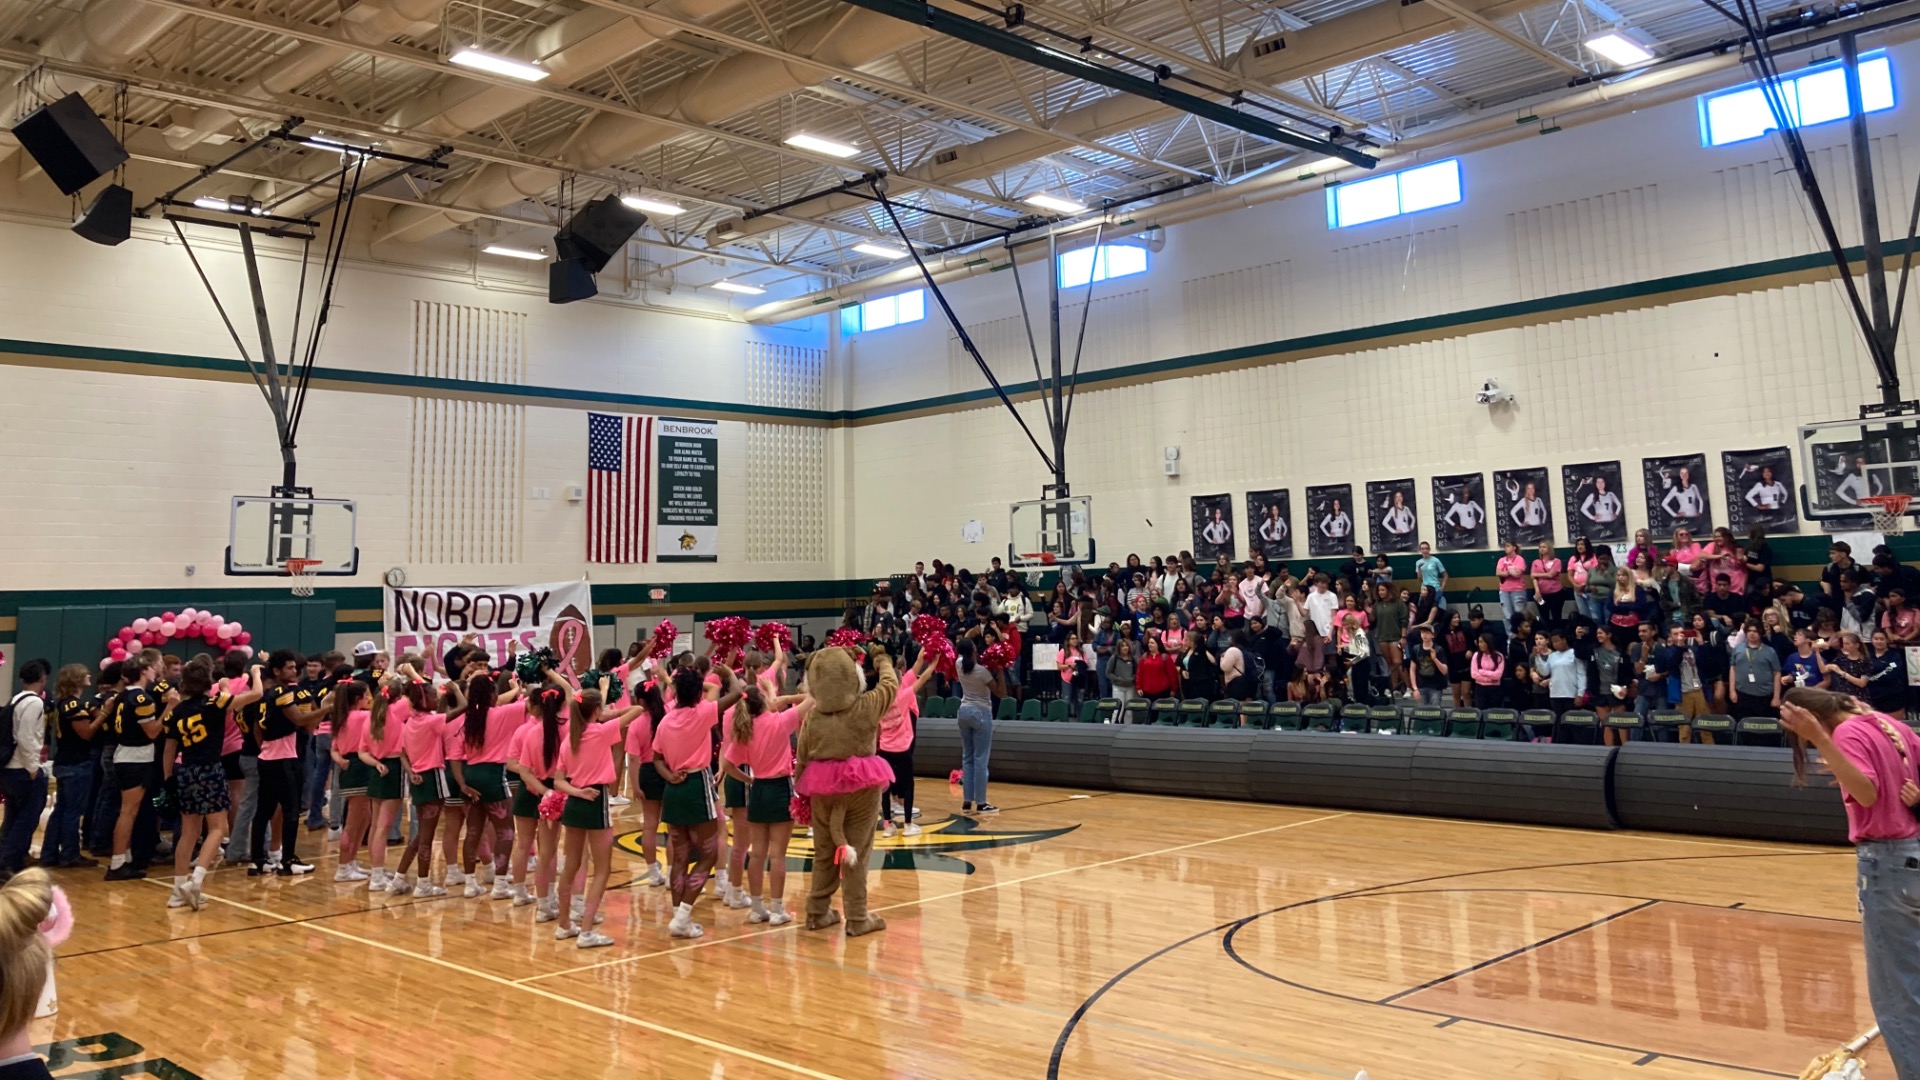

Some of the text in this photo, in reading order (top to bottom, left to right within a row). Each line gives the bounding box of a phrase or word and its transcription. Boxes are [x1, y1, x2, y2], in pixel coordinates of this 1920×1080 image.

[664, 425, 713, 434] BENBROOK
[1564, 468, 1577, 540] BENBROOK
[1604, 502, 1610, 511] 7
[1645, 461, 1658, 536] BENBROOK
[1725, 454, 1739, 532] BENBROOK
[1815, 447, 1832, 528] BENBROK
[1368, 485, 1378, 551] BENBROOK
[1433, 479, 1444, 547] BENBROOK
[1495, 474, 1506, 544] BENBROOK
[1616, 543, 1628, 554] 23
[394, 589, 550, 633] NOBODY
[395, 630, 537, 680] FIGTS
[136, 694, 146, 703] 6
[153, 679, 170, 693] 75
[275, 686, 284, 694] 7
[64, 700, 78, 712] 10
[115, 702, 124, 734] 6
[176, 713, 208, 748] 15
